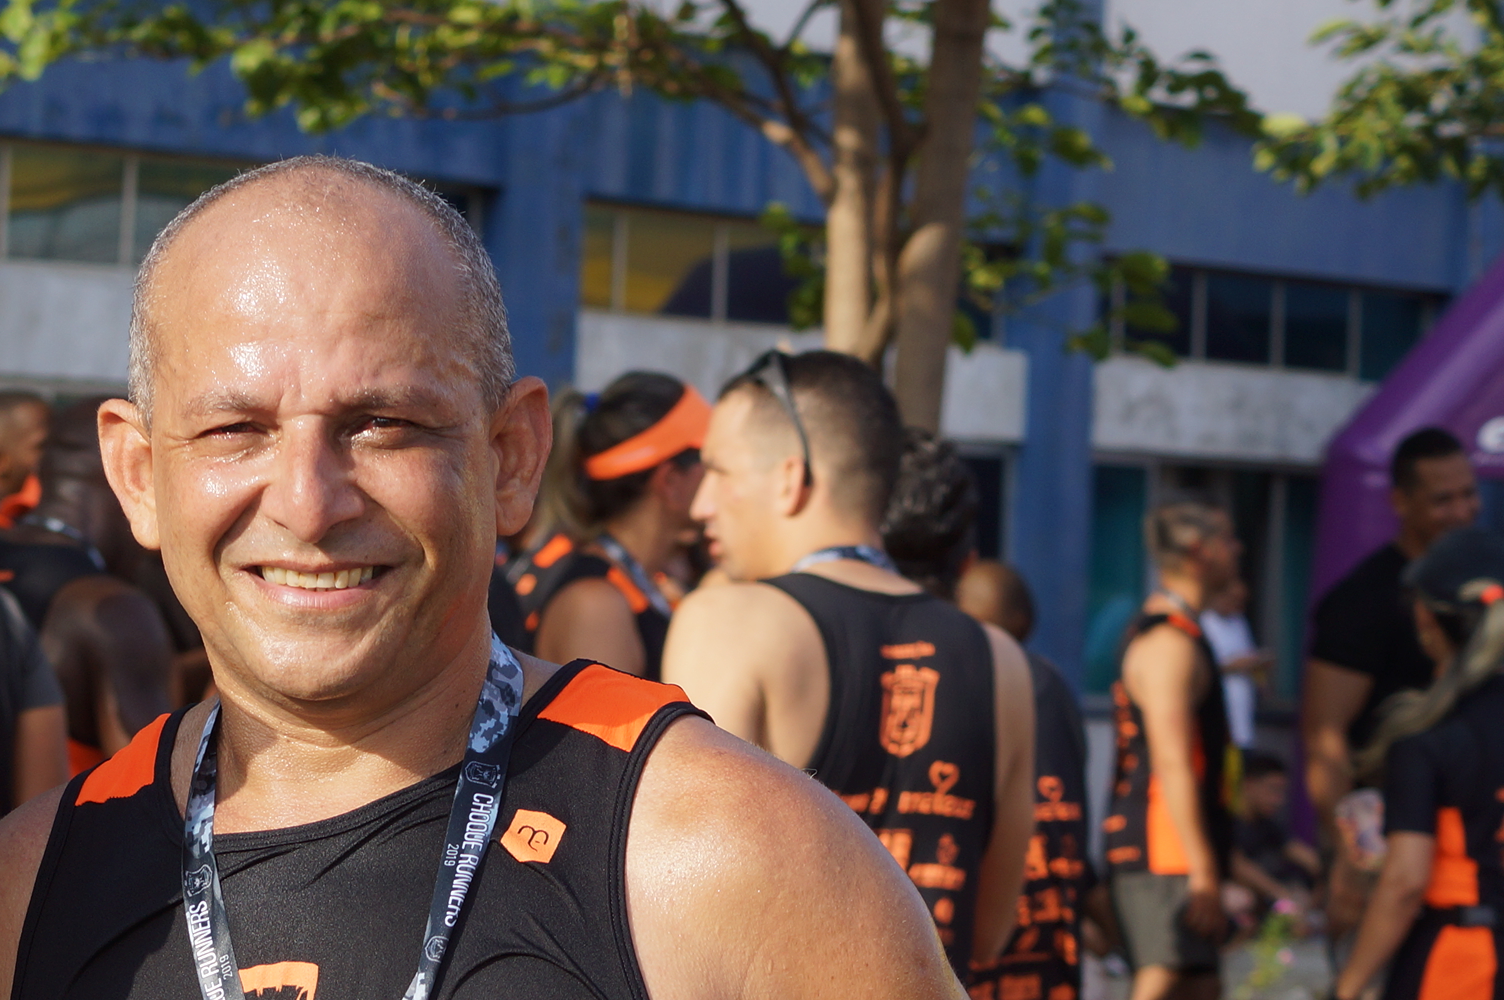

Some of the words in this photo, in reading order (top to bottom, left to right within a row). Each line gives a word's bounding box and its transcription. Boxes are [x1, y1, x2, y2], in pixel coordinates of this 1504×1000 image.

[461, 792, 494, 852] CHOQUE
[444, 843, 459, 867] 2019
[444, 853, 480, 928] RUNNERS
[189, 900, 220, 979] RUNNERS
[219, 954, 233, 980] 2019
